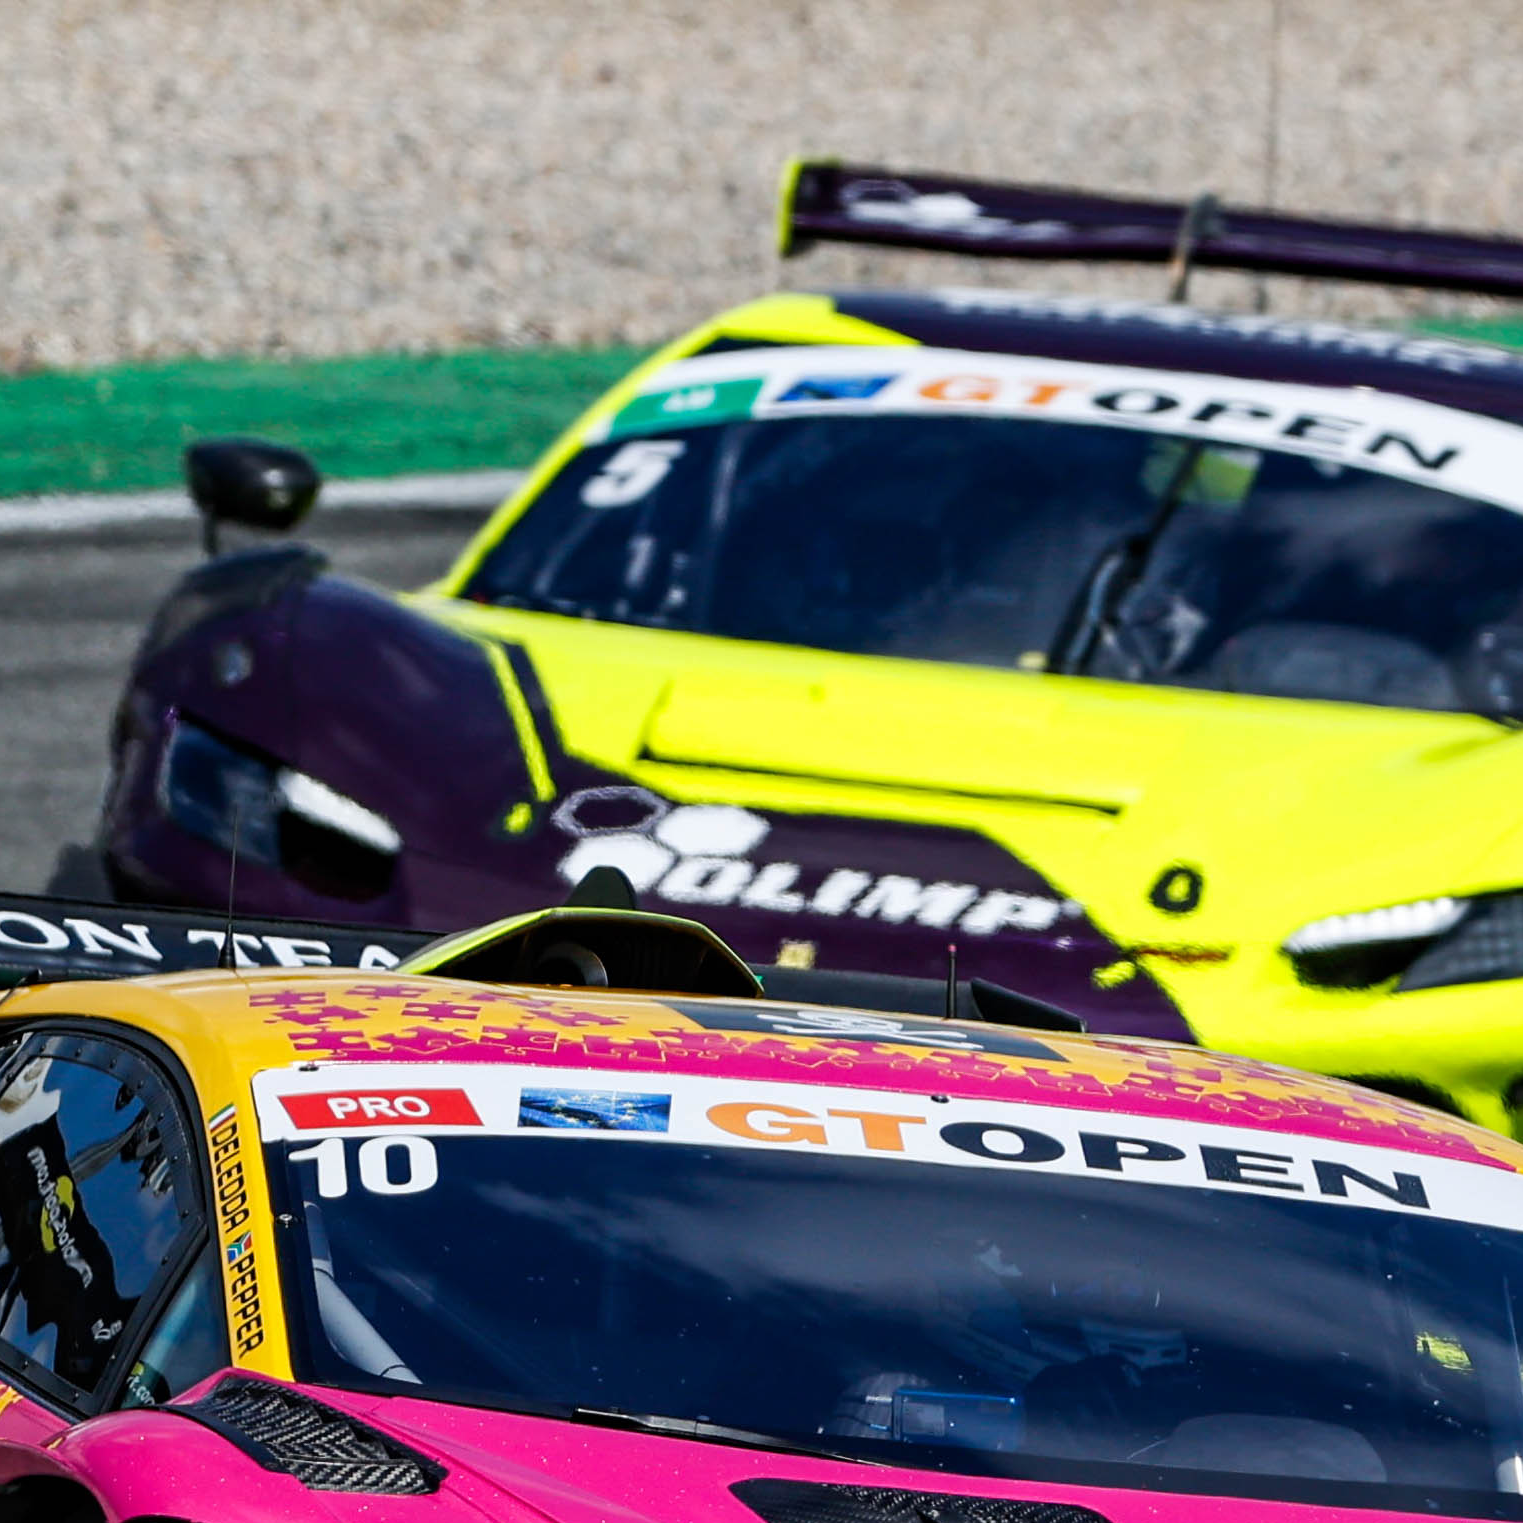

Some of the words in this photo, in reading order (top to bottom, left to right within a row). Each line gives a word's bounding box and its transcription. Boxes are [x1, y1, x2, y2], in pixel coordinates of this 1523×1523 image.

[581, 440, 685, 508] 5
[659, 856, 1062, 935] OLIMP
[186, 929, 401, 970] TEA
[326, 1096, 431, 1120] PRO
[211, 1121, 251, 1234] DELEDDA
[288, 1136, 439, 1198] 10
[229, 1251, 265, 1359] PEPPER
